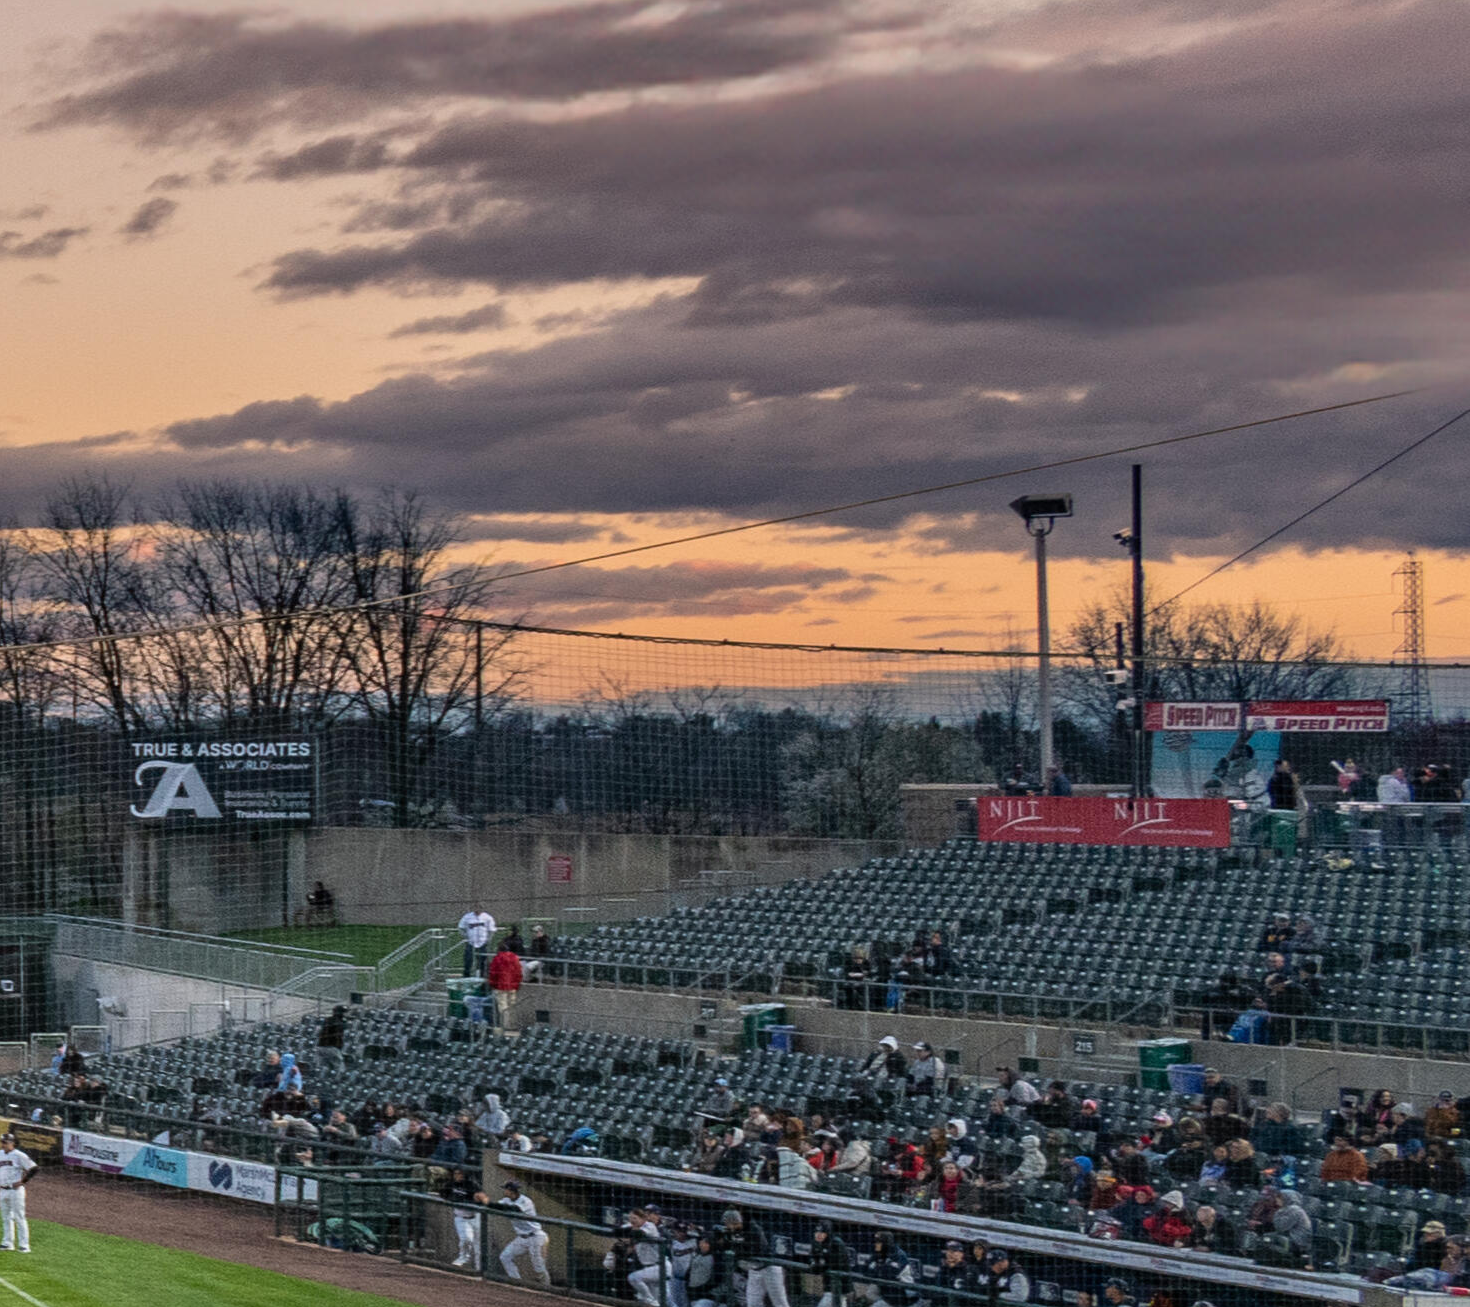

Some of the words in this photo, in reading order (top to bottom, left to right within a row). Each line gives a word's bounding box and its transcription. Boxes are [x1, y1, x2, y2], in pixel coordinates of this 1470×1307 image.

[1167, 705, 1204, 726] SPEED
[1205, 706, 1237, 728] PITCH
[1274, 717, 1331, 730] SPEED
[1335, 717, 1385, 731] PITCH
[132, 743, 178, 756] TRUE
[182, 743, 193, 756] &
[198, 743, 310, 757] ASSOCIATES
[991, 801, 1039, 818] NJIT
[1114, 802, 1166, 820] NJIT
